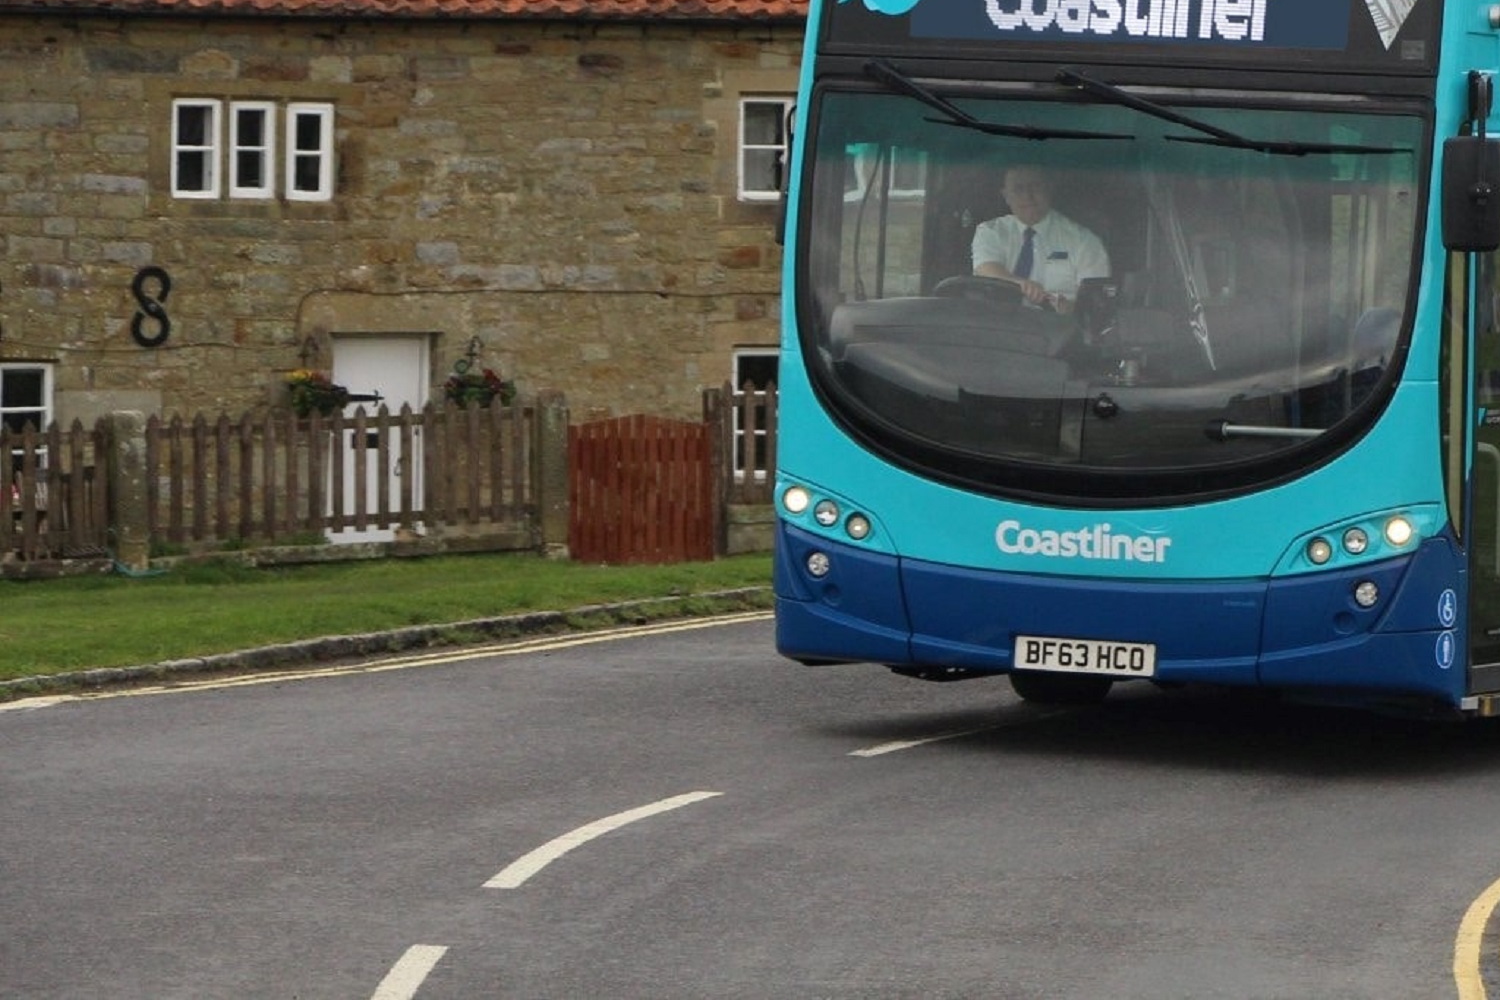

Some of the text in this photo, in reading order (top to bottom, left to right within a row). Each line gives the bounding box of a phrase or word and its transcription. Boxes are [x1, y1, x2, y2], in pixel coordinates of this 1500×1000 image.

[995, 519, 1171, 563] Coastliner
[1025, 640, 1145, 672] BF63 HCO
